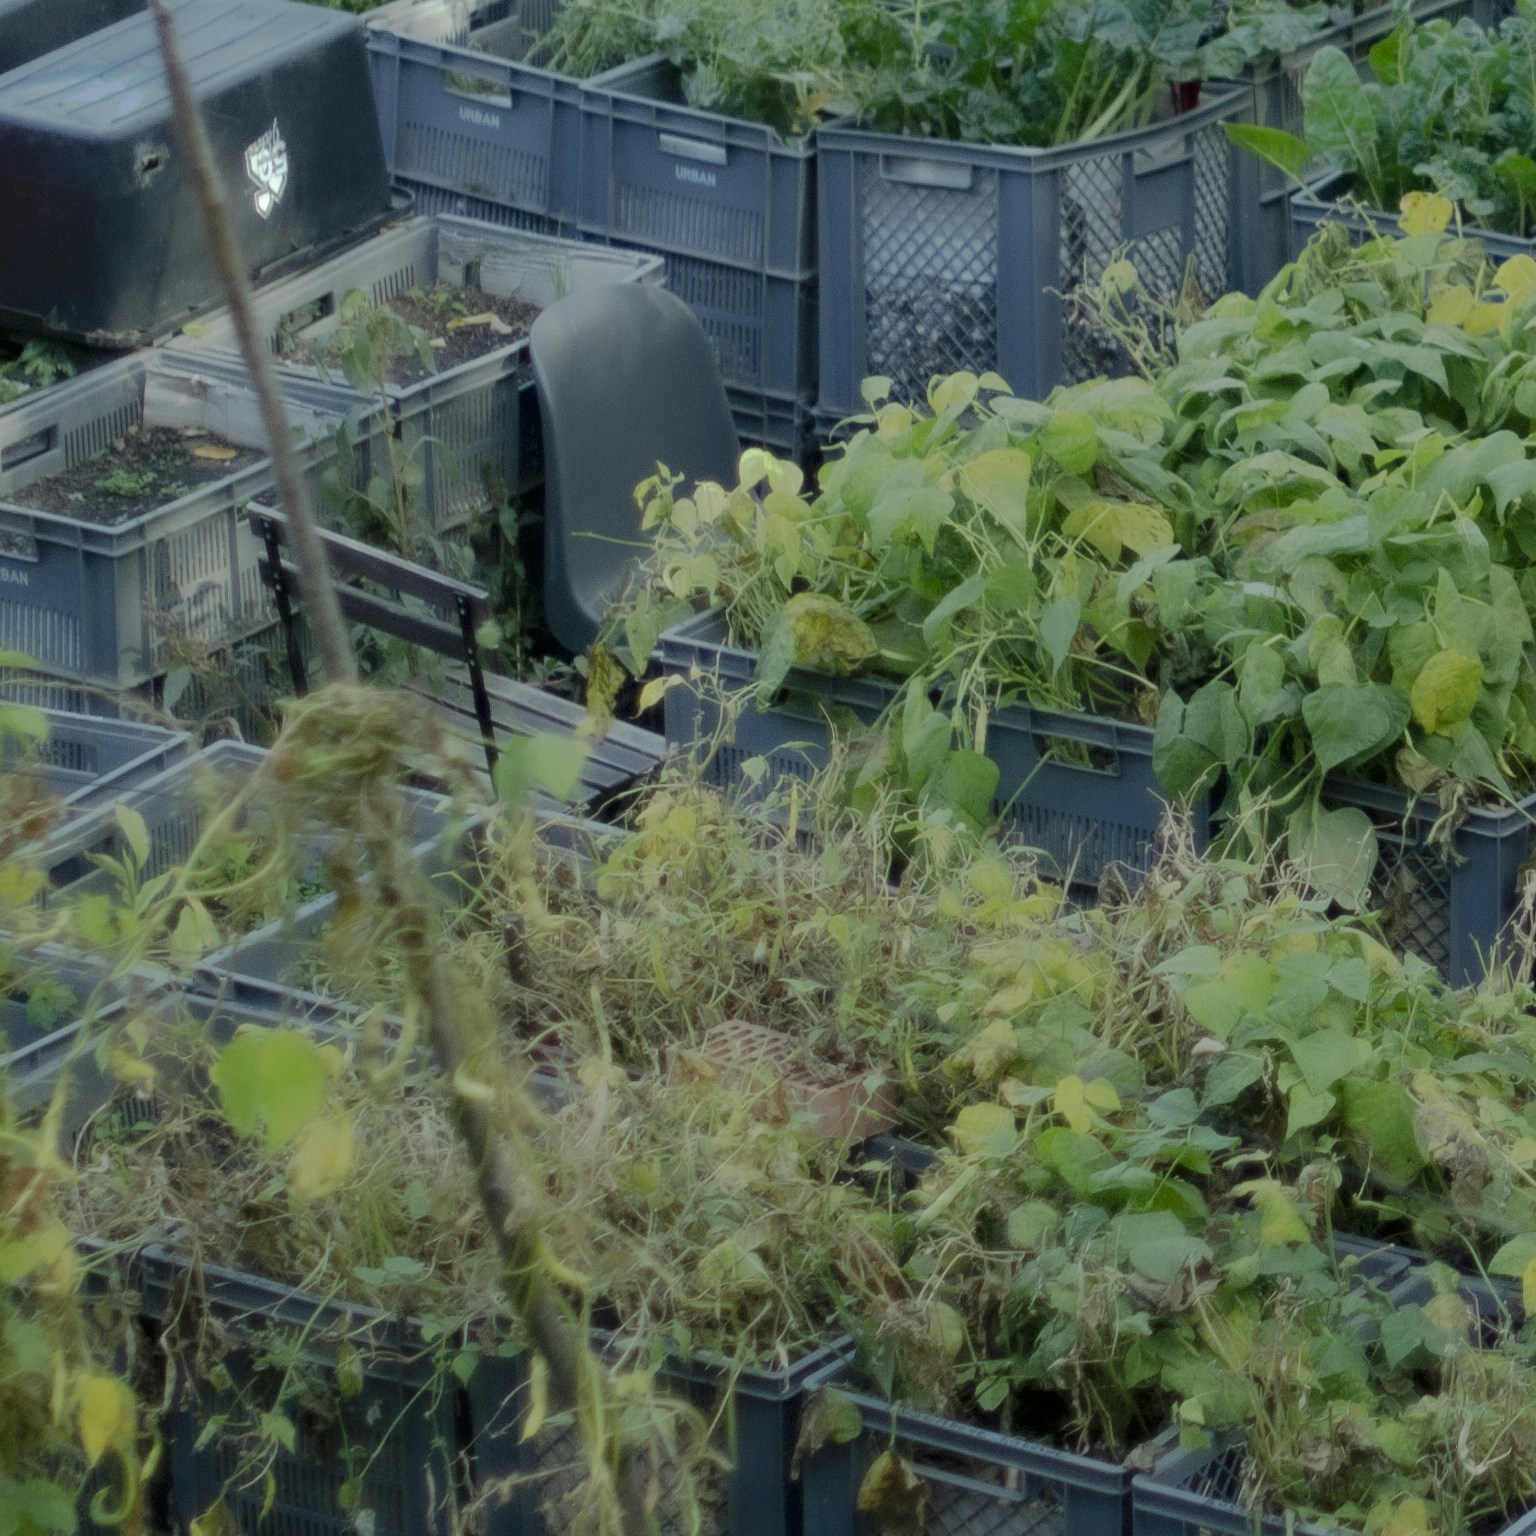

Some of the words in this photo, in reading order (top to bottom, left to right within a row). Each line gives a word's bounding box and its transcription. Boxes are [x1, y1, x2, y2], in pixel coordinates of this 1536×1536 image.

[460, 106, 500, 129] URBAN
[675, 164, 716, 186] URBAN
[0, 567, 29, 586] BAN
